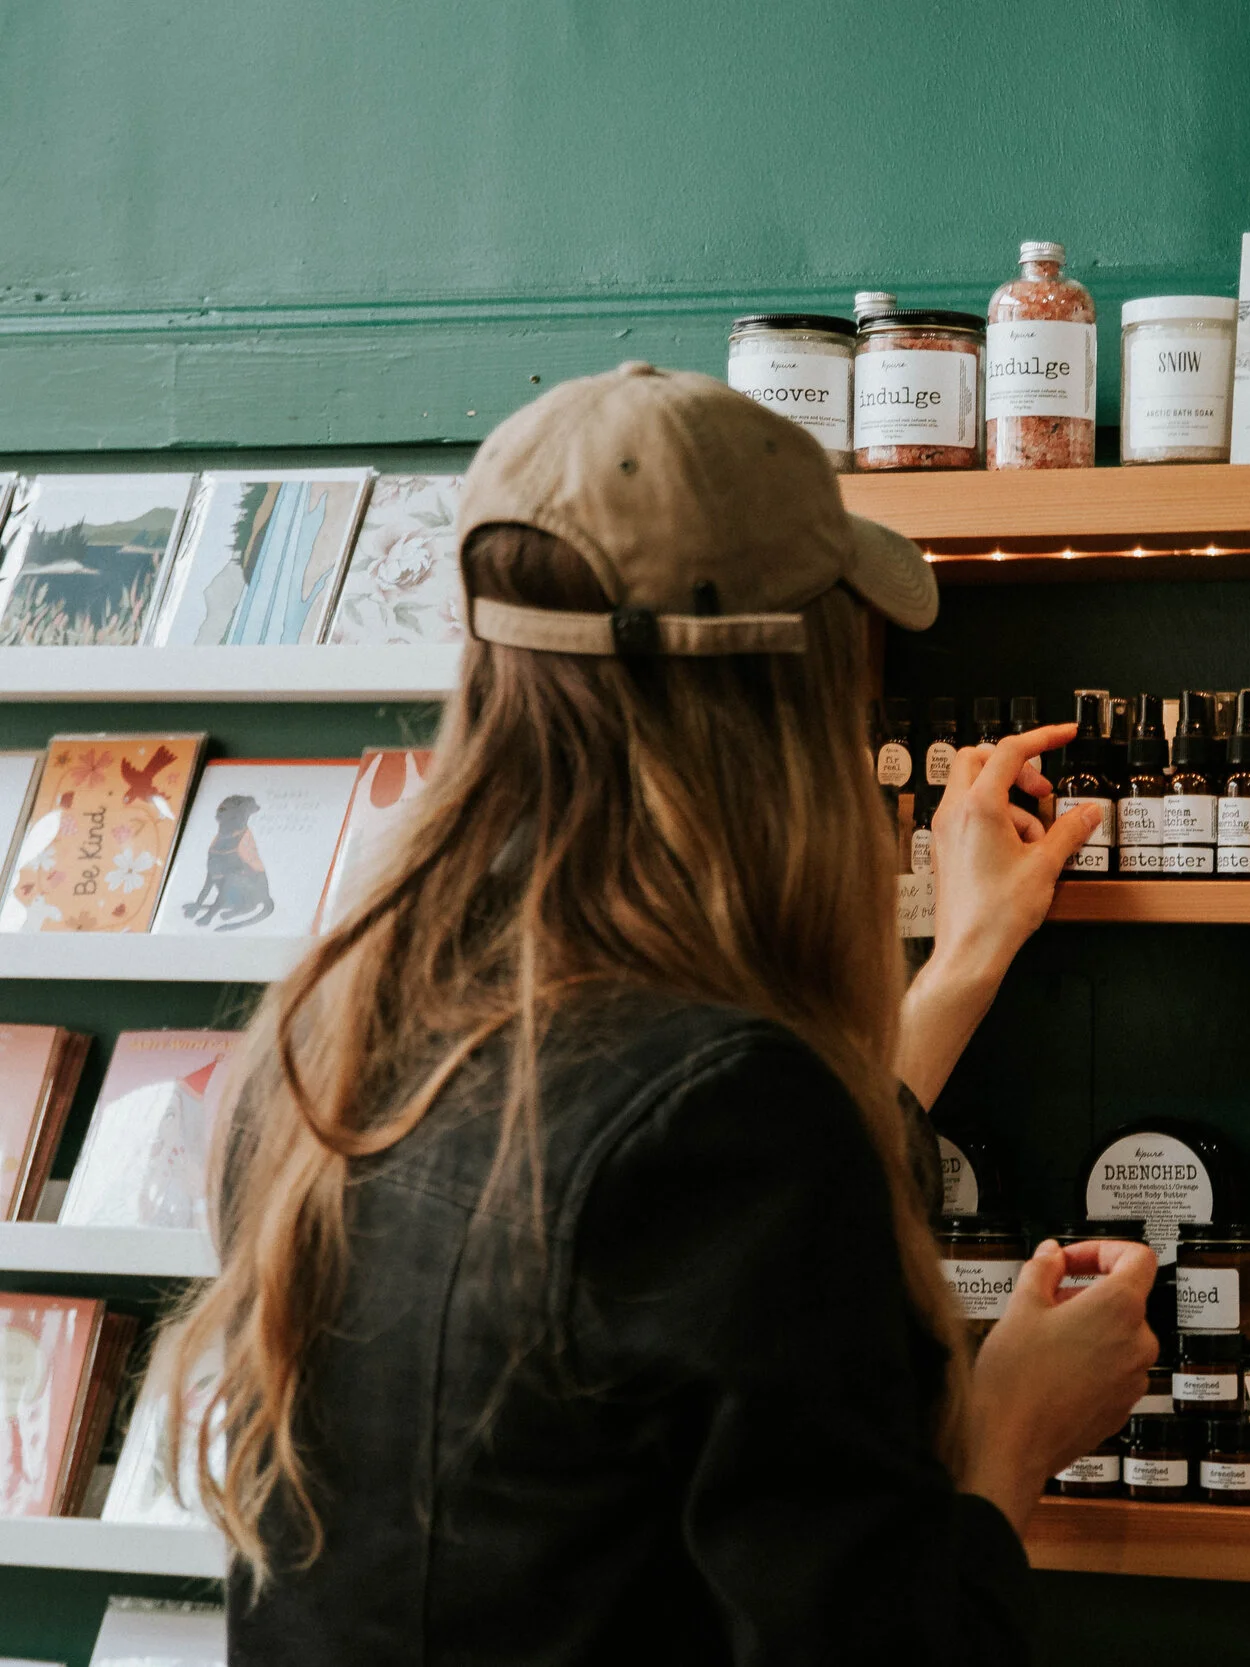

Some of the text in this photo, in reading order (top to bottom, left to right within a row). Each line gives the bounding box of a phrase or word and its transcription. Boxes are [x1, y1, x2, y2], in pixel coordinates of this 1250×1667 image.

[988, 356, 1071, 380] indulge
[1158, 351, 1202, 373] SNOW
[860, 386, 941, 410] indulge
[1173, 409, 1193, 417] BATH
[1194, 408, 1215, 417] SOAK
[1123, 806, 1149, 819] deep
[1164, 807, 1191, 818] ream
[1222, 810, 1240, 820] good
[1164, 853, 1207, 868] ester
[73, 864, 100, 896] Be
[1104, 1165, 1198, 1180] DRENCHED
[1113, 1191, 1188, 1199] Whipped Body Butter
[1183, 1380, 1220, 1390] drenched
